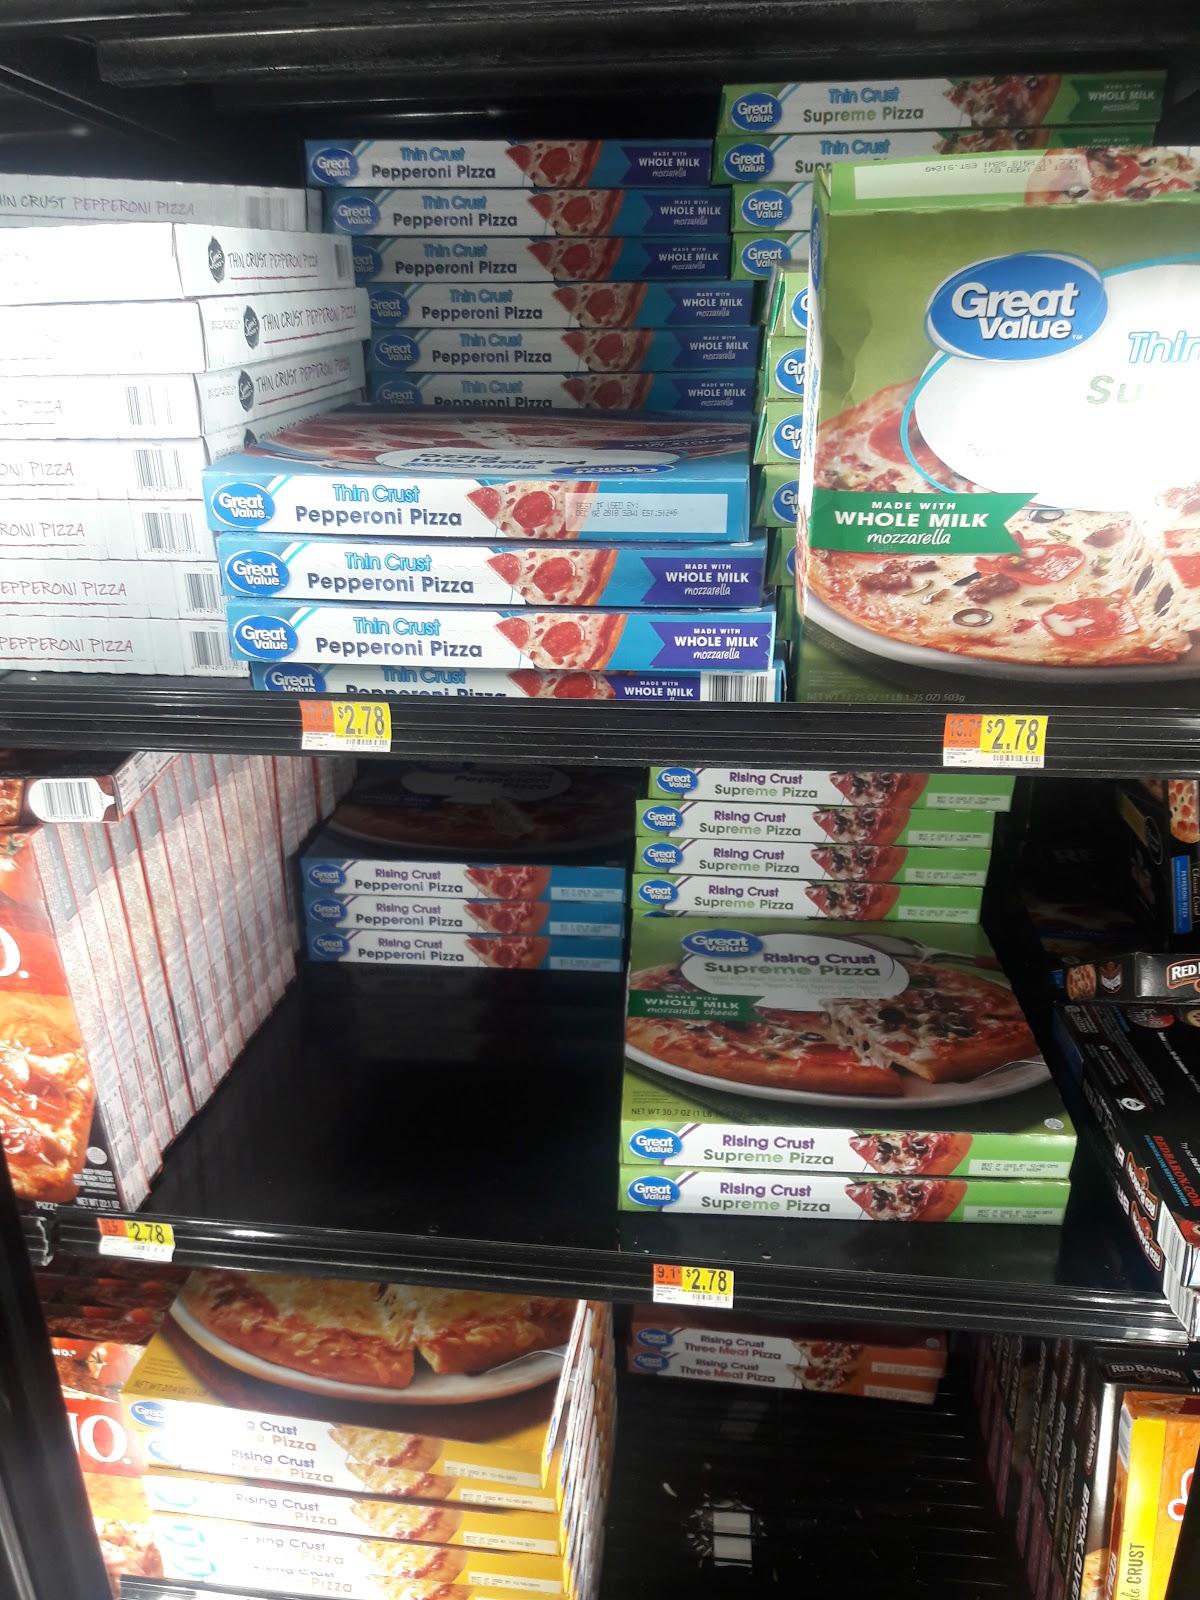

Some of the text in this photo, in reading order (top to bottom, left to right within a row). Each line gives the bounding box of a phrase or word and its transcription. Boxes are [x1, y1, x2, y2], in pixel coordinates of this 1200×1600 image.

[829, 87, 900, 104] Thin Crust
[737, 103, 773, 114] Great
[747, 113, 773, 123] Value
[803, 108, 923, 125] Supreme Pizza
[401, 147, 465, 161] Thin Crust
[317, 157, 350, 169] Great
[639, 157, 700, 167] WHOLE MILK
[325, 167, 350, 177] Value
[372, 165, 496, 181] Pepperoni Pizza
[20, 195, 195, 216] CRUST PEPPERONI PIZZA
[421, 195, 487, 210] Thin Crust
[337, 205, 372, 217] Great
[660, 206, 721, 215] WHOLE MILK
[393, 213, 517, 229] Pepperoni Pizza
[952, 281, 1079, 318] Great
[980, 315, 1072, 340] Value
[31, 462, 74, 476] PIZZA
[333, 484, 420, 502] Thin Crust
[219, 493, 264, 508] Great
[872, 501, 912, 509] MADE
[231, 507, 264, 518] Value
[296, 506, 462, 526] Pepperoni Pizza
[834, 511, 989, 527] WHOLE MILK
[41, 522, 85, 538] PIZZA
[867, 529, 951, 545] mozzarella
[345, 552, 432, 571] Thin Crust
[233, 562, 278, 576] Great
[246, 576, 280, 586] Value
[307, 573, 474, 593] Pepperoni Pizza
[666, 572, 749, 582] WHOLE MILK
[84, 582, 127, 596] PIZZA
[685, 585, 730, 595] mozzarella
[354, 617, 441, 636] Thin Crust
[242, 627, 286, 641] Great
[91, 637, 133, 652] PIZZA
[254, 638, 288, 650] Value
[316, 638, 482, 658] Pepperoni Pizza
[674, 637, 758, 647] WHOLE MILK
[694, 649, 739, 660] mozzarella
[624, 687, 693, 697] WHOLE MILK
[338, 706, 384, 735] $2.78
[987, 719, 1038, 750] $2.78
[662, 775, 691, 783] Great
[730, 772, 802, 785] Rising Crust
[715, 785, 817, 798] Supreme Pizza
[375, 869, 440, 880] Rising Crust
[355, 880, 463, 892] Pepperoni Pizza
[643, 887, 671, 895] Great
[709, 885, 779, 897] Rising Crust
[694, 897, 793, 910] Supreme Pizza
[378, 938, 442, 949] Rising Crust
[692, 936, 748, 947] Great
[706, 944, 749, 952] Value
[358, 949, 464, 961] Pepperoni Pizza
[763, 952, 875, 966] Rising Crust
[705, 962, 880, 976] Supreme Pizza
[704, 1008, 738, 1016] cheese
[636, 1135, 673, 1147] Great
[723, 1135, 815, 1150] Rising Crust
[644, 1145, 673, 1153] Value
[704, 1149, 833, 1165] Supreme Pizza
[634, 1183, 671, 1194] Great
[720, 1183, 811, 1198] Rising Crust
[701, 1196, 830, 1212] Supreme Pizza
[687, 1269, 726, 1291] $2.78
[701, 1335, 764, 1348] Rising Crust
[685, 1343, 781, 1359] Three Meat Pizza
[696, 1359, 759, 1370] Rising Crust
[1136, 1365, 1181, 1378] BARON
[680, 1366, 775, 1382] Three Meat Pizza
[260, 1421, 298, 1435] Crust
[272, 1435, 316, 1451] Pizza
[278, 1455, 315, 1468] Crust
[291, 1468, 333, 1483] Pizza
[283, 1499, 319, 1511] Crust
[290, 1539, 325, 1550] Crust
[1127, 1543, 1145, 1585] CRUST
